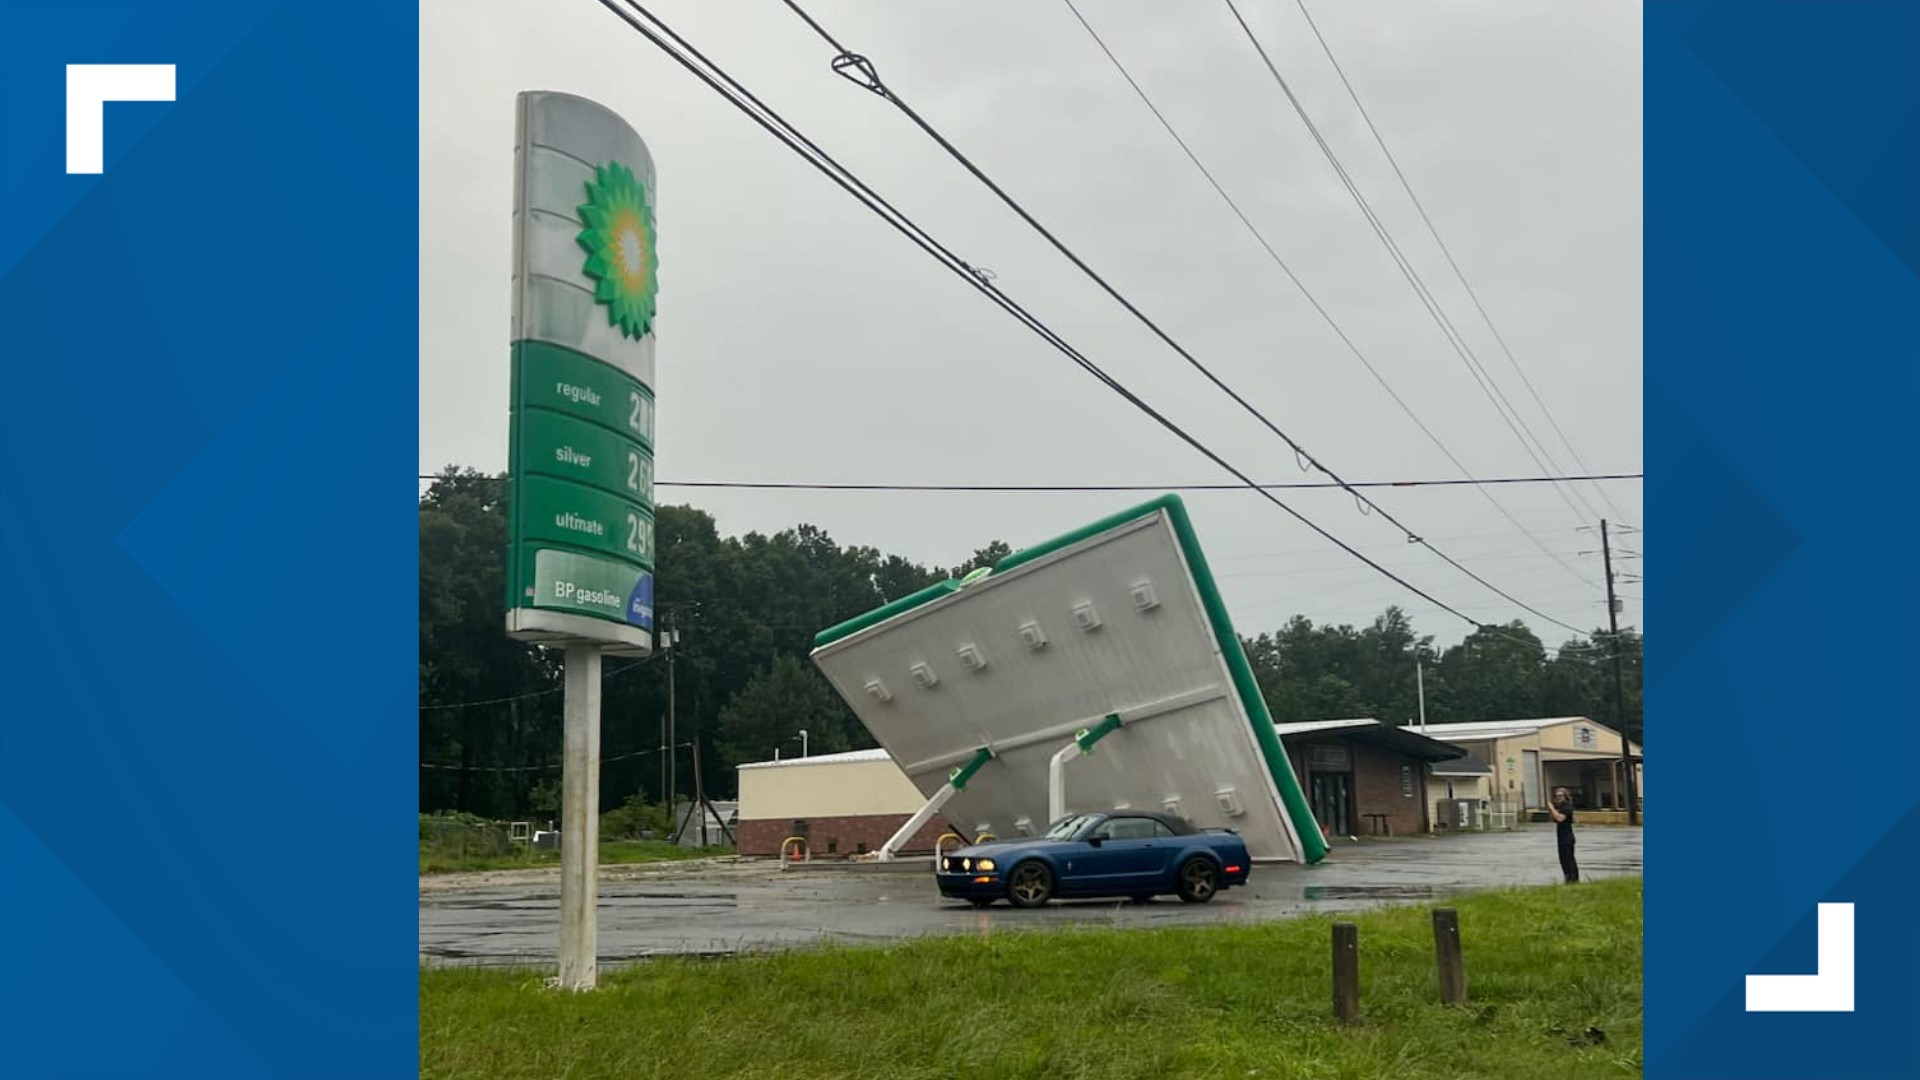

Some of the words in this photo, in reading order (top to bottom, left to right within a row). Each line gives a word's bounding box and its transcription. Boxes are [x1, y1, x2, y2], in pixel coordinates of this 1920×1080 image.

[556, 381, 602, 407] regular
[556, 446, 592, 467] silver
[556, 511, 604, 536] ultimate
[555, 581, 575, 598] BP
[576, 588, 621, 609] gasoline
